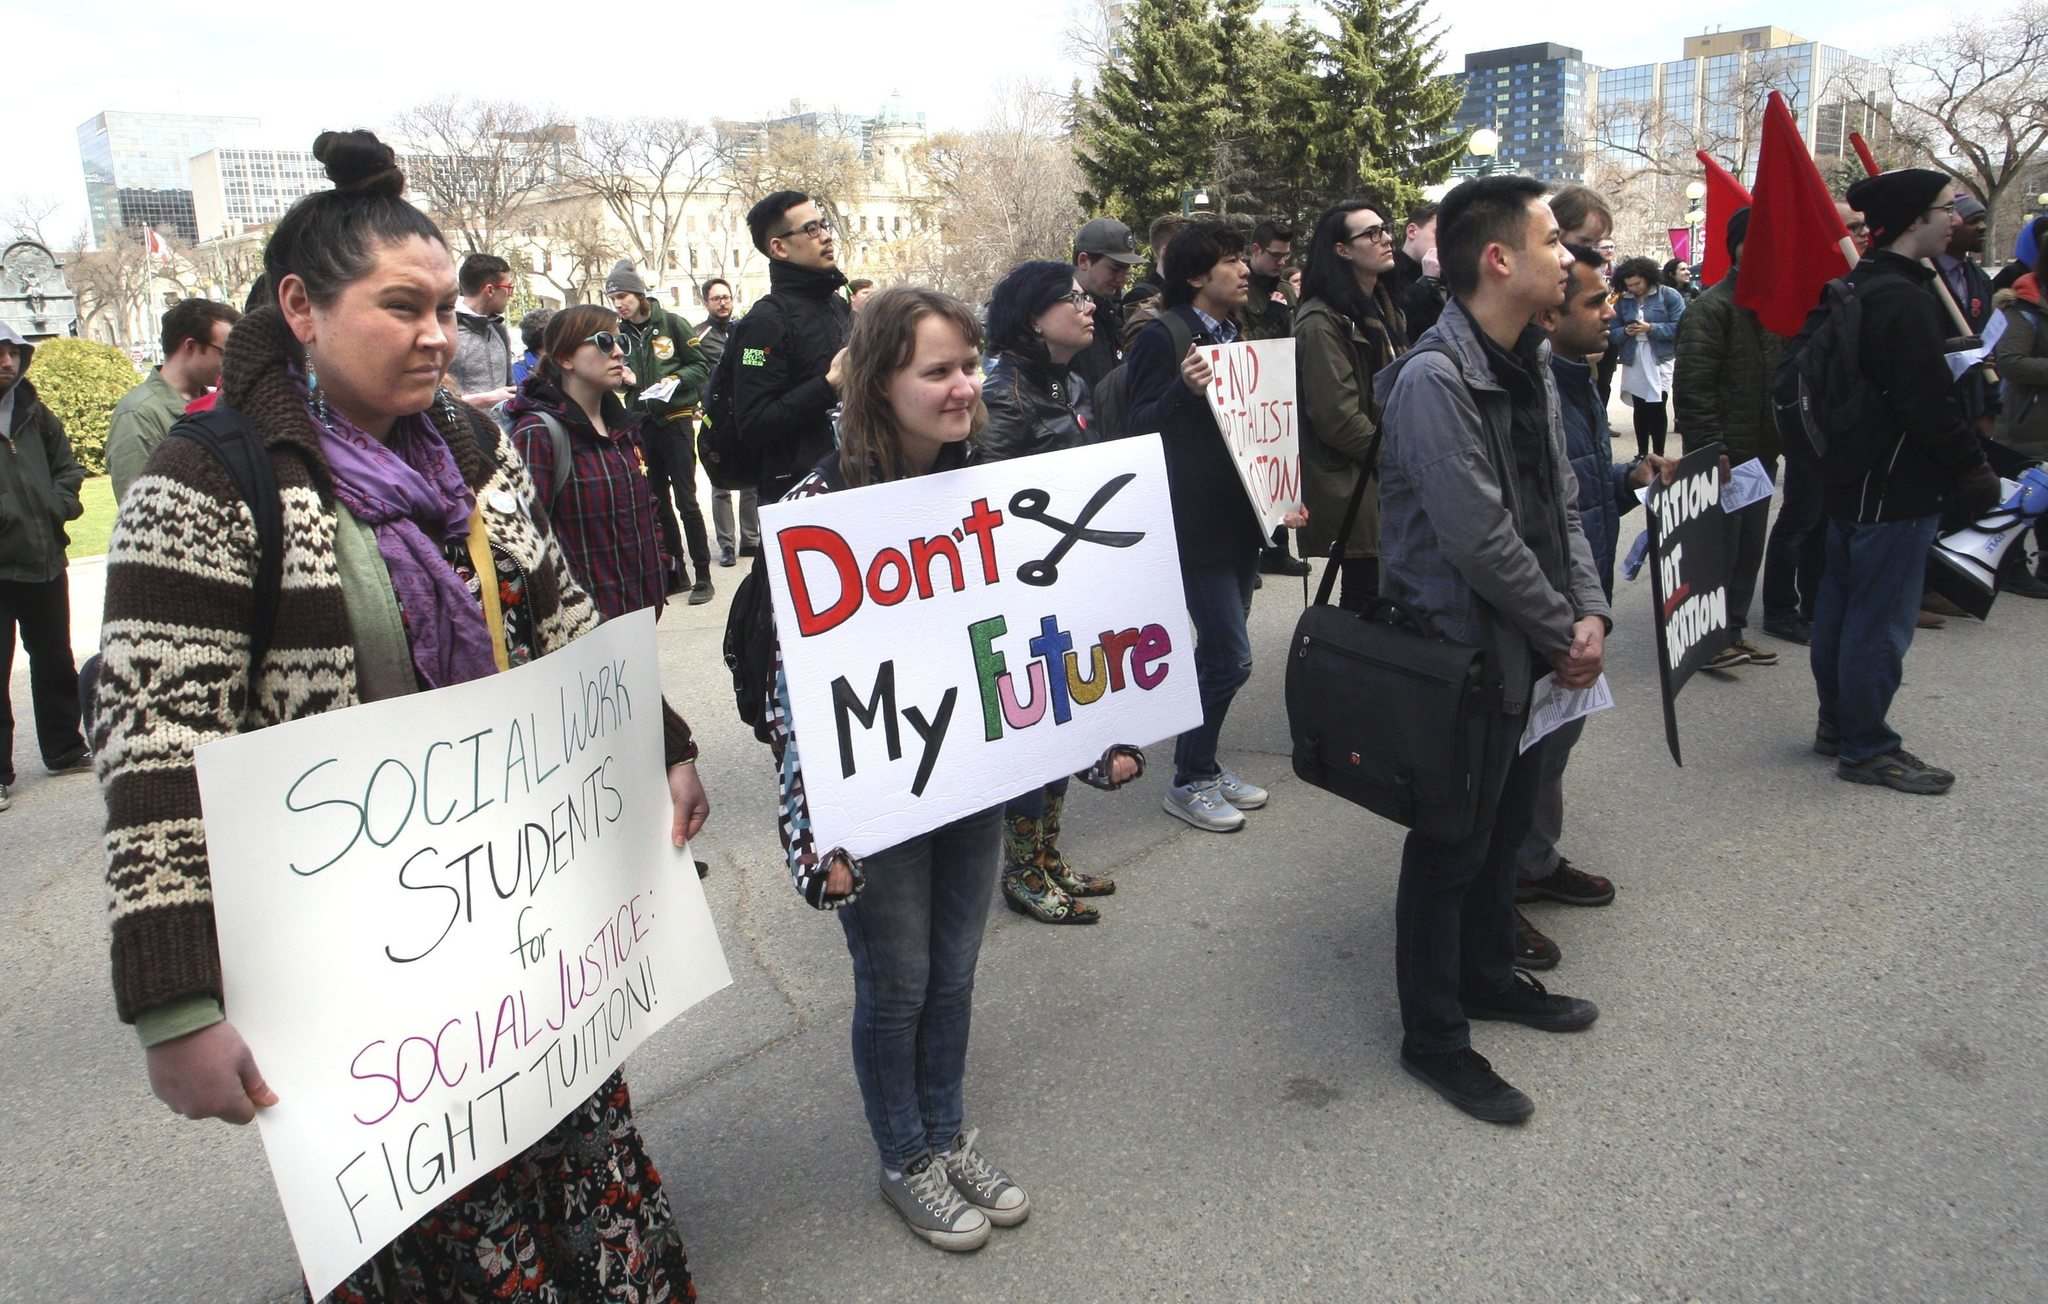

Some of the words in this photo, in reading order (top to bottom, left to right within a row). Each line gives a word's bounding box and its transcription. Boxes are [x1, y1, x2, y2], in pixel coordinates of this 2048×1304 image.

[1211, 344, 1260, 408] END
[777, 497, 1004, 638] Don't
[1660, 541, 1682, 605] OT
[286, 713, 560, 875] SOCIAL
[561, 658, 633, 758] WORK
[831, 659, 958, 798] My
[967, 614, 1173, 742] Future
[385, 755, 623, 963] STUDENTS
[510, 906, 553, 970] for
[335, 1072, 521, 1243] FIGHT
[529, 955, 658, 1108] TUITION!
[350, 994, 545, 1125] SOCIAL
